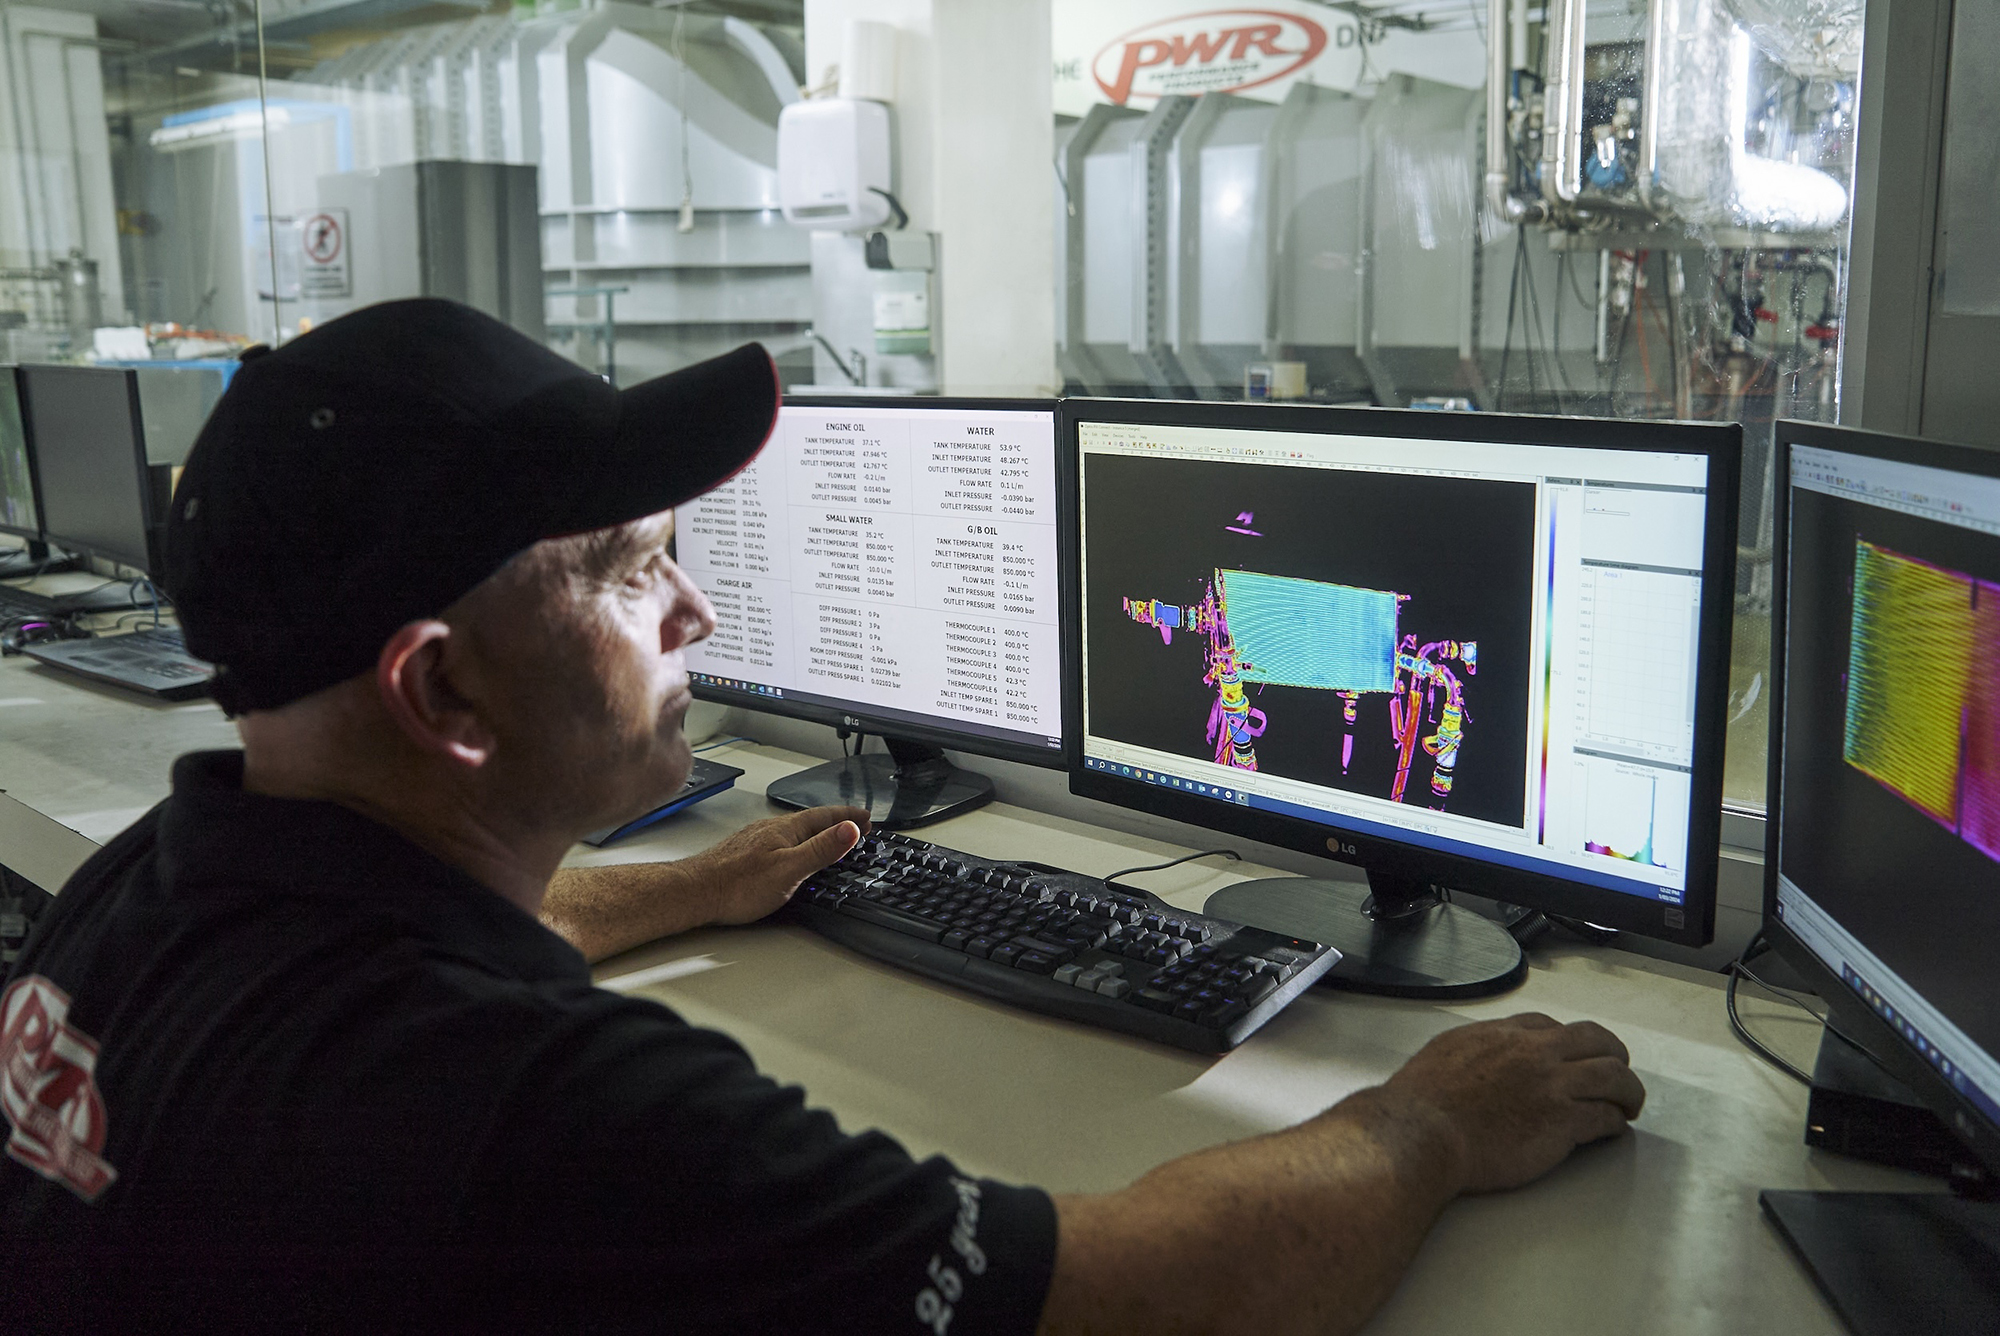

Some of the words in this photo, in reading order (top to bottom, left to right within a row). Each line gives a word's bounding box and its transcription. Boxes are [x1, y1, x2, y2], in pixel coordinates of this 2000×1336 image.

[1109, 25, 1285, 104] PWR
[826, 423, 852, 431] ENGINE
[853, 423, 865, 432] OIL
[966, 427, 995, 436] WATER
[819, 437, 855, 445] TEMPERATURE
[950, 442, 991, 451] TEMPERATURE
[999, 444, 1013, 452] 53.9
[819, 449, 855, 457] TEMPERATURE
[950, 454, 991, 463] TEMPERATURE
[820, 460, 856, 469] TEMPERATURE
[928, 465, 949, 473] OUTLET
[950, 466, 992, 476] TEMPERATURE
[1000, 469, 1021, 477] 42.795
[874, 474, 886, 482] L/m
[959, 479, 976, 487] FLOW
[977, 480, 992, 488] RATE
[1000, 481, 1010, 489] 0.1
[1011, 482, 1024, 490] L/m
[815, 482, 830, 490] INLET
[830, 483, 856, 492] PRESSURE
[811, 493, 830, 501] OUTLET
[831, 494, 857, 503] PRESSURE
[944, 490, 961, 498] INLET
[963, 491, 992, 500] PRESSURE
[1001, 494, 1024, 502] -0.0390
[1024, 495, 1034, 503] bar
[940, 502, 962, 510] OUTLET
[963, 503, 993, 513] PRESSURE
[1001, 506, 1024, 515] -0.0440
[967, 525, 983, 535] G/B
[984, 526, 998, 536] OIL
[936, 537, 952, 545] TANK
[953, 539, 994, 549] TEMPERATURE
[1002, 543, 1015, 551] 39.4
[935, 549, 952, 557] INLET
[953, 551, 994, 562] TEMPERATURE
[1002, 555, 1026, 565] 850.000
[931, 561, 952, 569] OUTLET
[953, 563, 994, 574] TEMPERATURE
[1002, 568, 1026, 577] 850.000
[962, 576, 979, 584] FLOW
[980, 577, 995, 586] RATE
[1003, 580, 1015, 588] -0.1
[1016, 582, 1029, 590] L/m
[947, 586, 964, 594] INLET
[965, 588, 995, 598] PRESSURE
[1003, 592, 1024, 601] 0.0165
[943, 597, 965, 606] OUTLET
[966, 600, 995, 610] PRESSURE
[1003, 604, 1024, 613] 0.0090
[945, 621, 991, 634] THERMOCOUPLE
[1004, 629, 1021, 637] 400.0
[946, 632, 991, 646] THERMOCOUPLE
[1004, 641, 1021, 650] 400.0
[946, 644, 991, 657] THERMOCOUPLE
[1004, 653, 1021, 662] 400.0
[946, 656, 992, 669] THERMOCOUPLE
[1005, 665, 1022, 674] 400.0
[947, 667, 992, 681] THERMOCOUPLE
[1005, 677, 1018, 685] 42.3
[947, 679, 992, 693] THERMOCOUPLE
[1006, 689, 1019, 697] 42.2
[940, 689, 957, 698] INLET
[958, 692, 974, 700] TEMP
[974, 695, 993, 705] SPARE
[1006, 700, 1030, 711] 850.000
[936, 700, 957, 710] OUTLET
[958, 704, 974, 712] TEMP
[975, 707, 993, 716] SPARE
[1006, 712, 1030, 723] 850.000
[1341, 842, 1357, 856] LG
